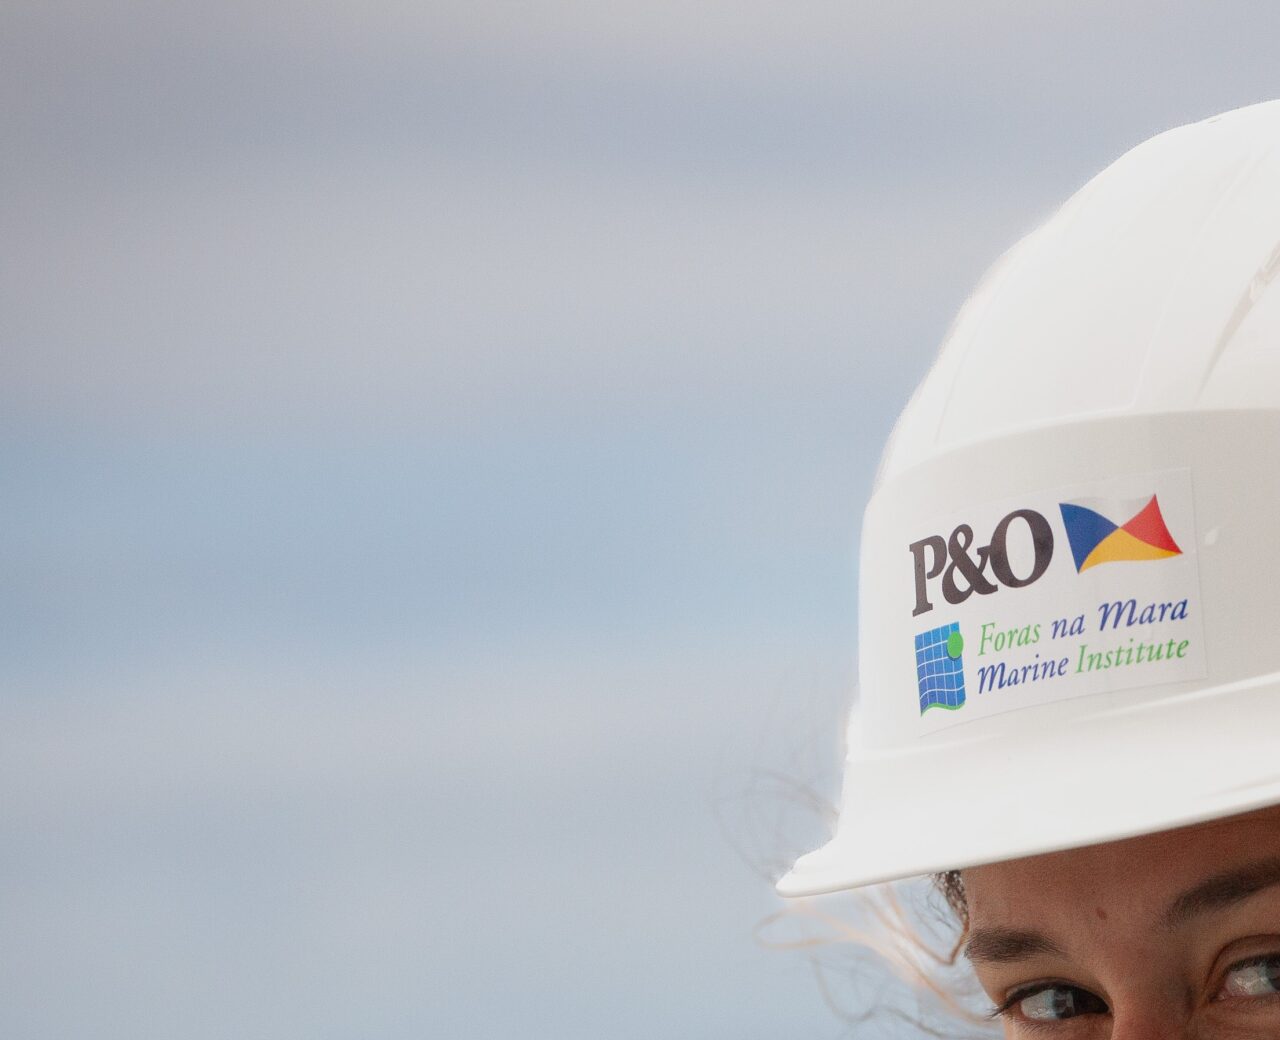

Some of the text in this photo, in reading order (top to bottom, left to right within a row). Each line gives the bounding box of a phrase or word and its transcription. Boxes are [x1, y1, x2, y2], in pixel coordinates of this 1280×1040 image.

[909, 509, 1054, 617] P&O
[978, 598, 1188, 656] Foras na Mara
[977, 639, 1189, 694] Marine Institute
